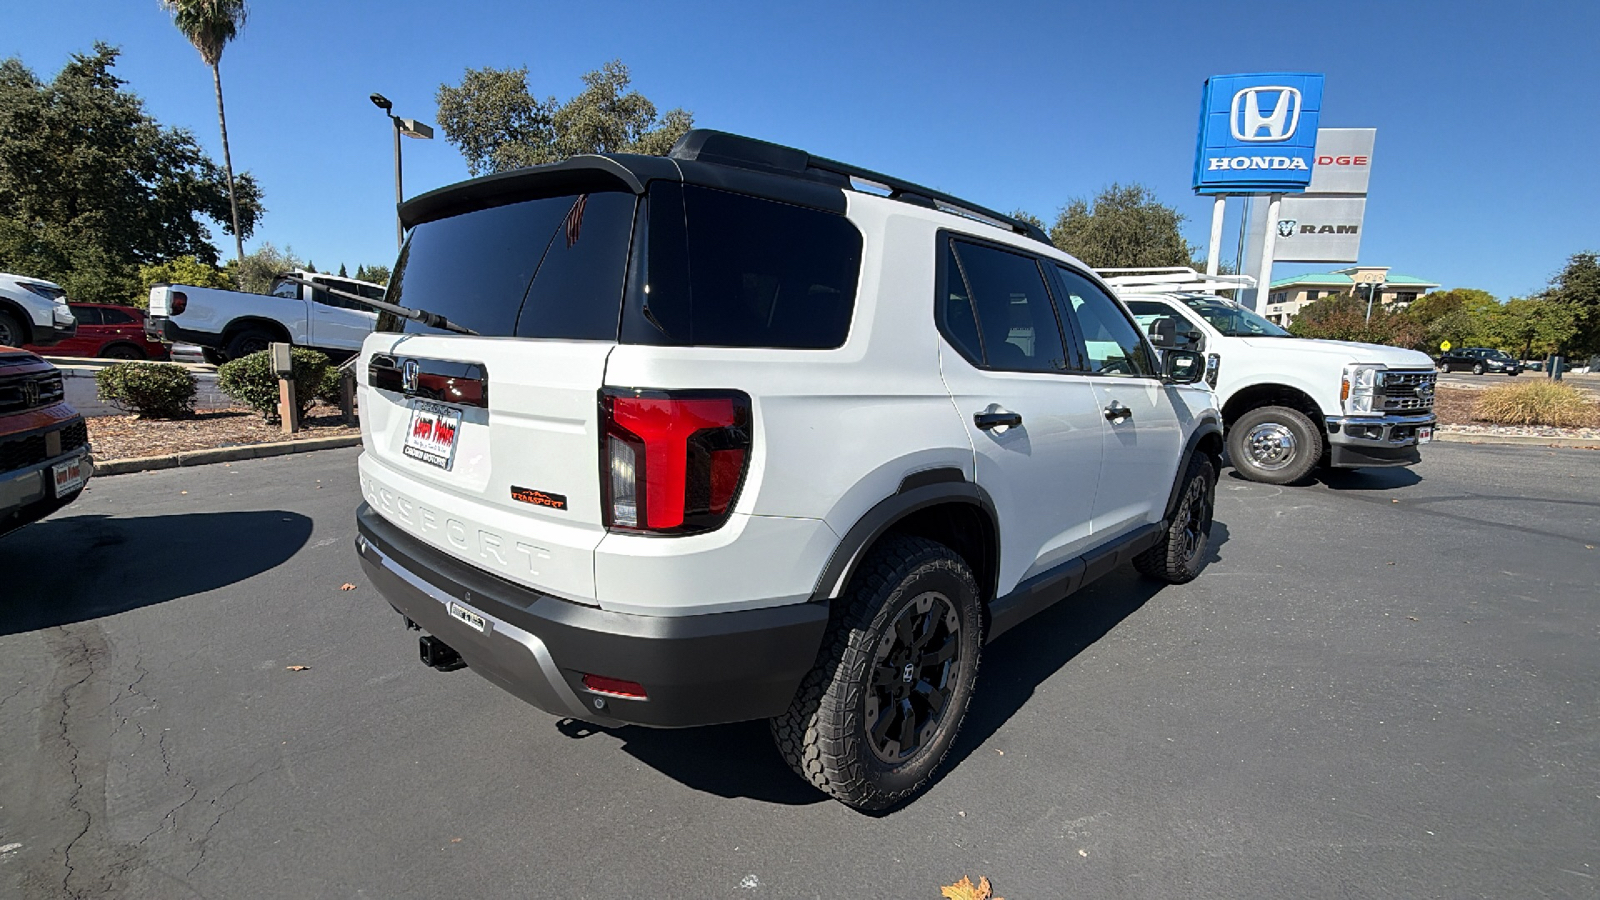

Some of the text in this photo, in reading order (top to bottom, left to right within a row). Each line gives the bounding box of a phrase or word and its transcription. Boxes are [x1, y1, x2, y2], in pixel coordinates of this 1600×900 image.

[1208, 156, 1309, 171] HONDA
[1313, 156, 1367, 166] DGE
[1300, 224, 1358, 234] RAM
[360, 471, 551, 576] PASSPORT
